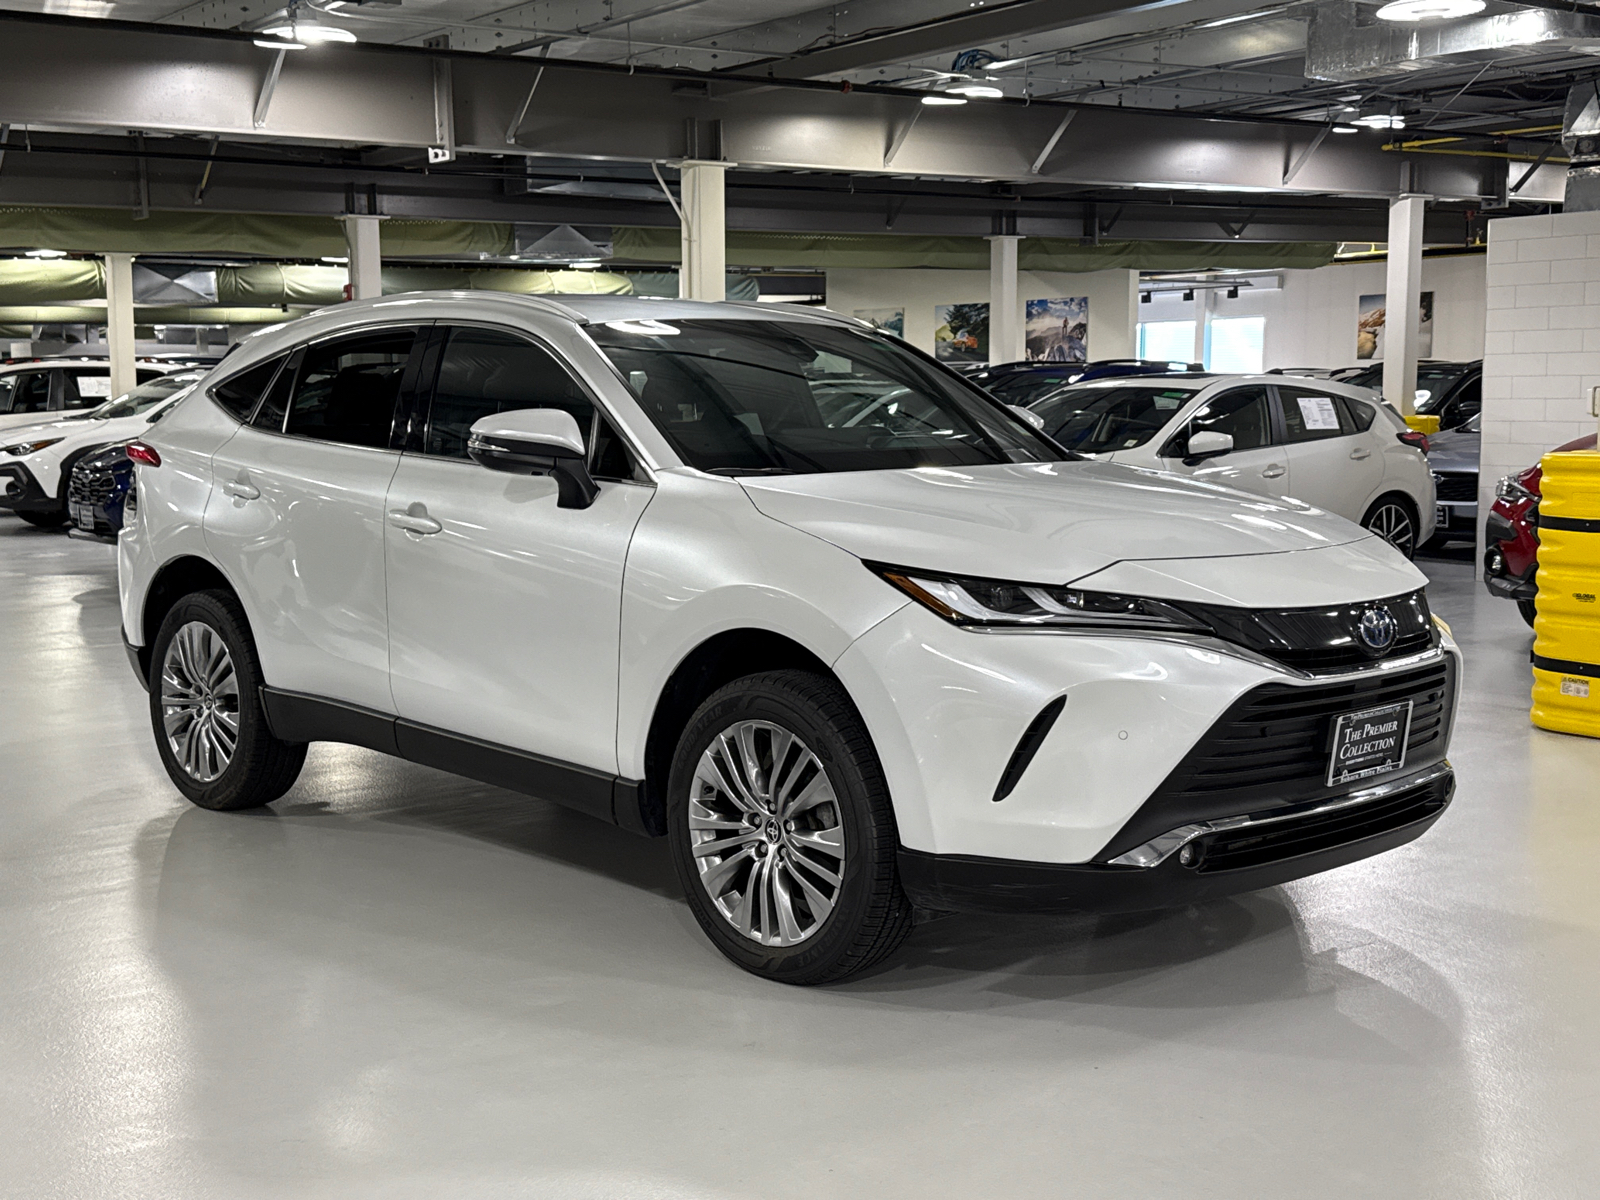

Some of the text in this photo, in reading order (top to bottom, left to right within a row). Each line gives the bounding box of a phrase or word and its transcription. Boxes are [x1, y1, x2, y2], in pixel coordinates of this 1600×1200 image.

[1344, 721, 1398, 743] THE PREMIER
[1340, 737, 1396, 759] COLLECTION
